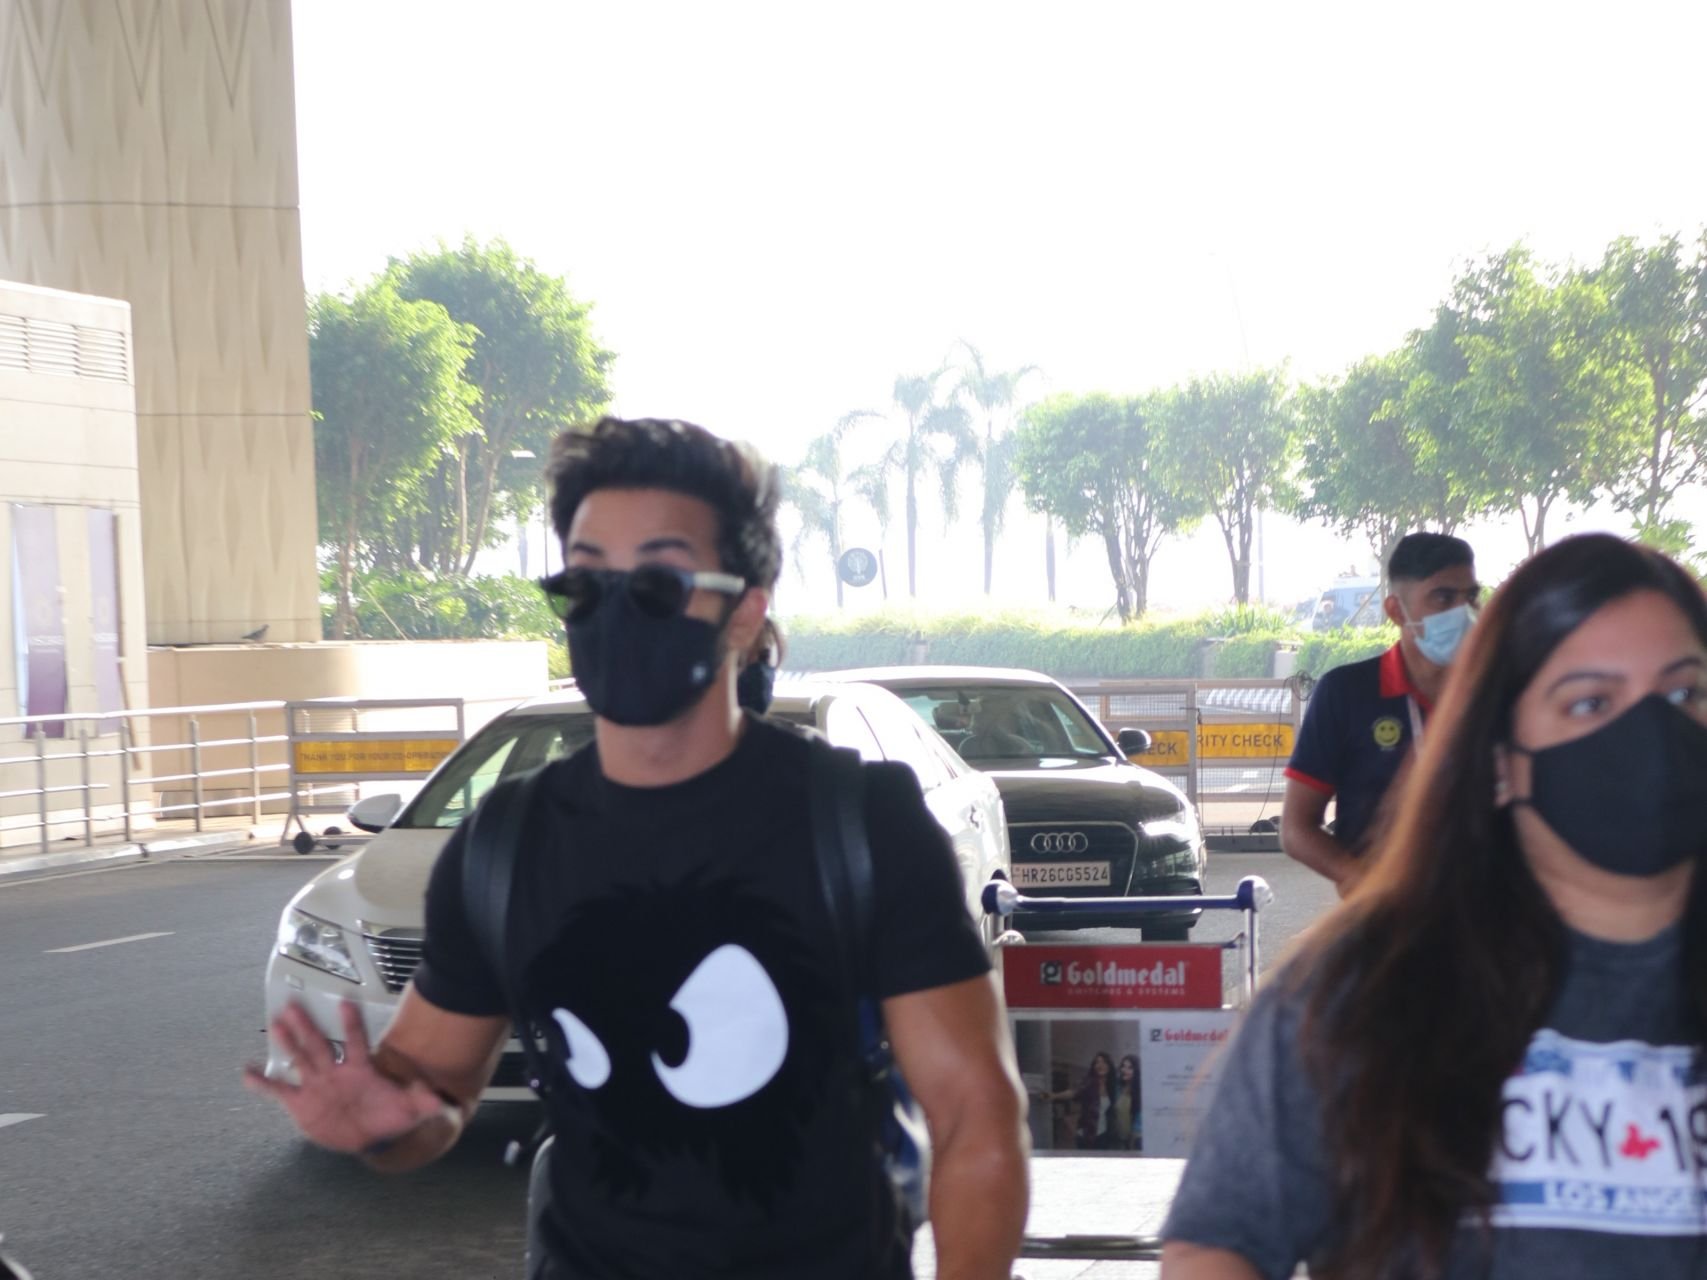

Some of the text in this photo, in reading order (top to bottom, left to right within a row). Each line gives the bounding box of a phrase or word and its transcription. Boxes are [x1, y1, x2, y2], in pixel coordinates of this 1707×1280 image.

[1232, 733, 1283, 748] CHECK
[1144, 741, 1178, 756] ECK
[1067, 960, 1185, 985] Goldmedal
